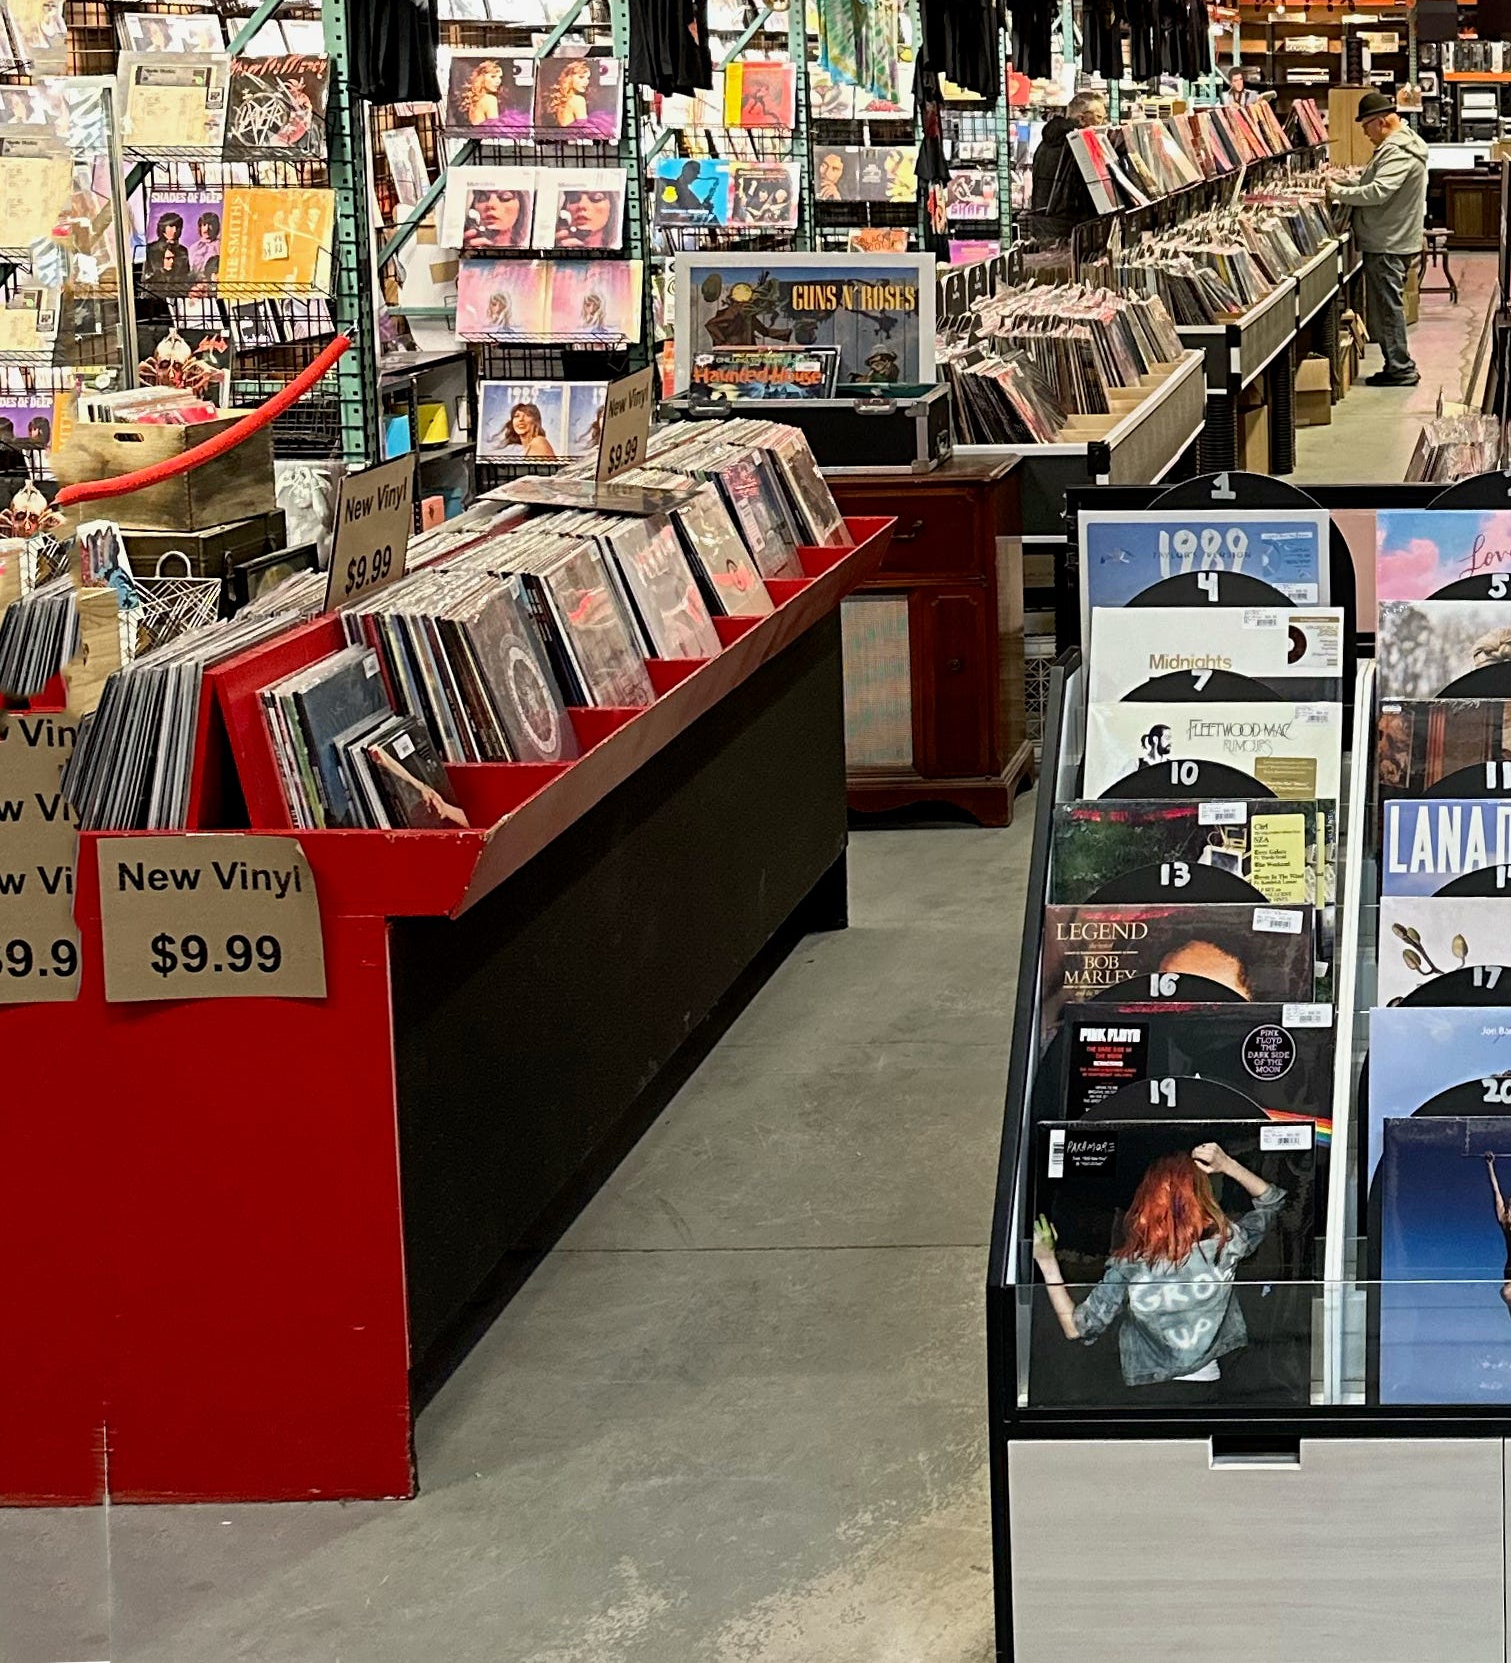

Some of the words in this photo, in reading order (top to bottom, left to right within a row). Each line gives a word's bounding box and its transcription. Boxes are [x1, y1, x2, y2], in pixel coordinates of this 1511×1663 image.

[151, 191, 186, 204] SHADES
[187, 191, 199, 203] OF
[200, 191, 223, 203] DEEP
[951, 202, 990, 216] SHAFT
[792, 285, 837, 311] GUNS
[862, 285, 917, 311] ROSES
[693, 364, 768, 384] Haunted
[609, 392, 627, 420] New
[627, 382, 649, 413] Vinyl
[608, 436, 638, 475] $9.99
[1211, 472, 1237, 500] 1
[344, 494, 374, 523] New
[375, 476, 407, 511] Vinyl
[1159, 527, 1249, 579] 1989
[345, 544, 393, 596] $9.99
[1197, 572, 1219, 602] 4
[1488, 574, 1510, 598] 5
[1149, 653, 1232, 670] Midnights
[1191, 670, 1213, 692] 7
[1187, 719, 1261, 741] FLEETWOOD
[1171, 761, 1199, 785] 10
[1389, 805, 1488, 874] LANA
[118, 862, 201, 891] New
[212, 861, 302, 899] Vinyl
[1160, 861, 1191, 887] 13
[1056, 922, 1148, 940] LEGEND
[0, 939, 78, 977] 9.9
[151, 932, 282, 978] $9.99
[1084, 955, 1119, 969] BOB
[1063, 969, 1137, 984] MARLEY
[1150, 972, 1180, 998] 16
[1473, 966, 1502, 989] 17
[1080, 1028, 1107, 1042] PINK
[1107, 1028, 1141, 1043] FLOYD
[1480, 1026, 1496, 1036] Jon
[1254, 1058, 1266, 1066] OF
[1267, 1058, 1283, 1066] THE
[1150, 1078, 1176, 1107] 19
[1164, 1319, 1212, 1349] UP
